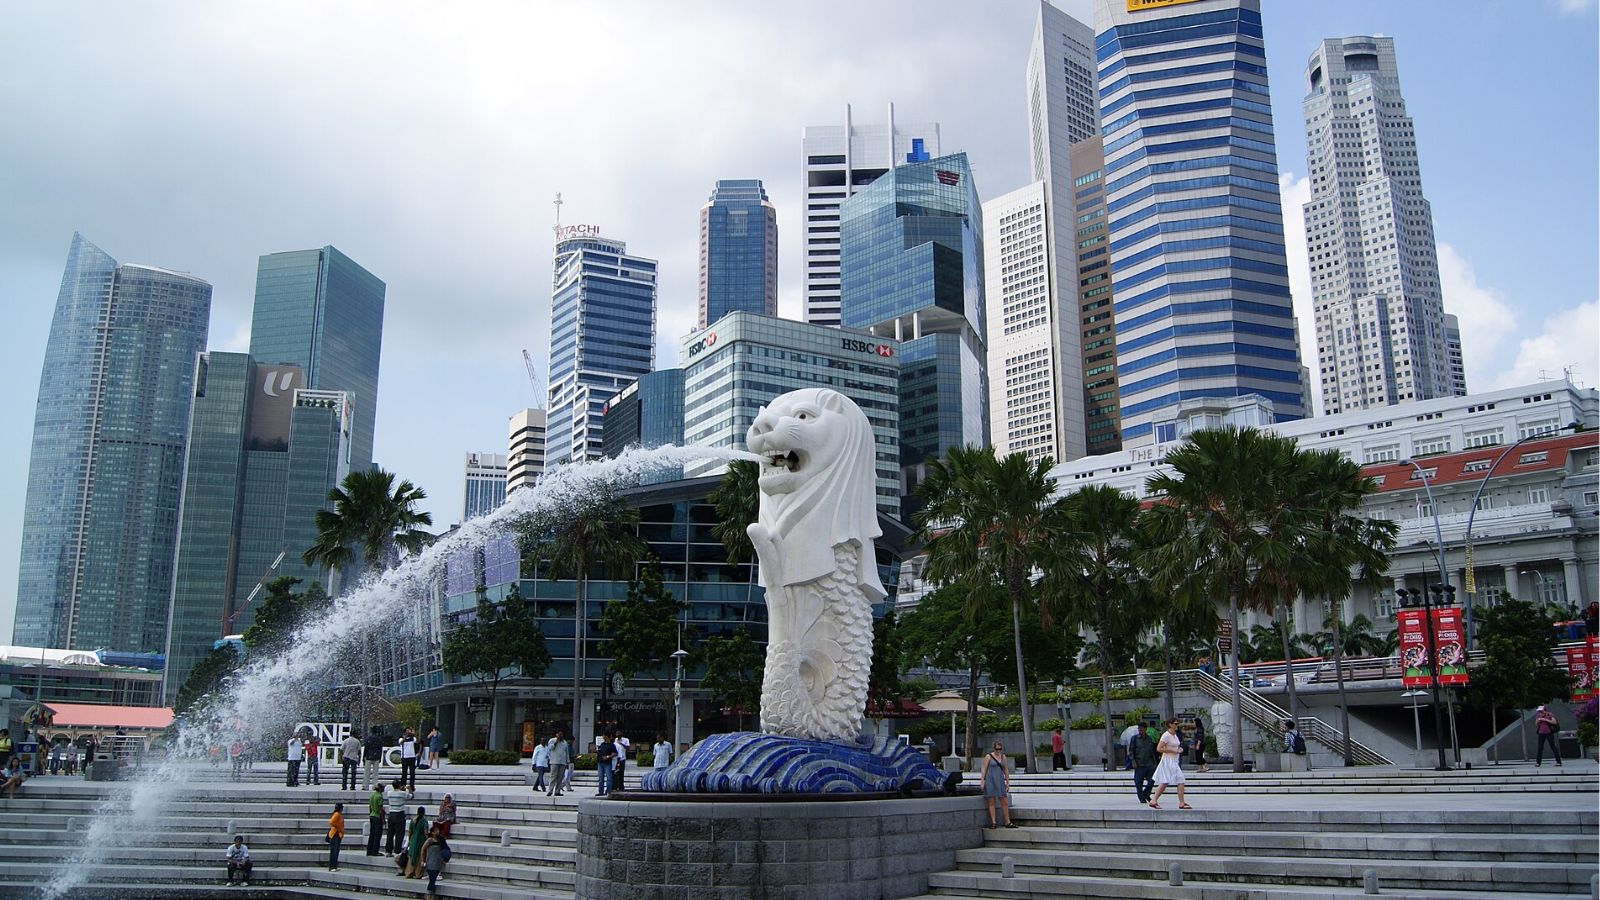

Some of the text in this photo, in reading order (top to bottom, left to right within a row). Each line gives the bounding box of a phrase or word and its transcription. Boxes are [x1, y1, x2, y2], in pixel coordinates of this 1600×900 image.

[689, 338, 707, 358] HSBC
[842, 338, 875, 354] HSBC
[1129, 449, 1153, 462] THE
